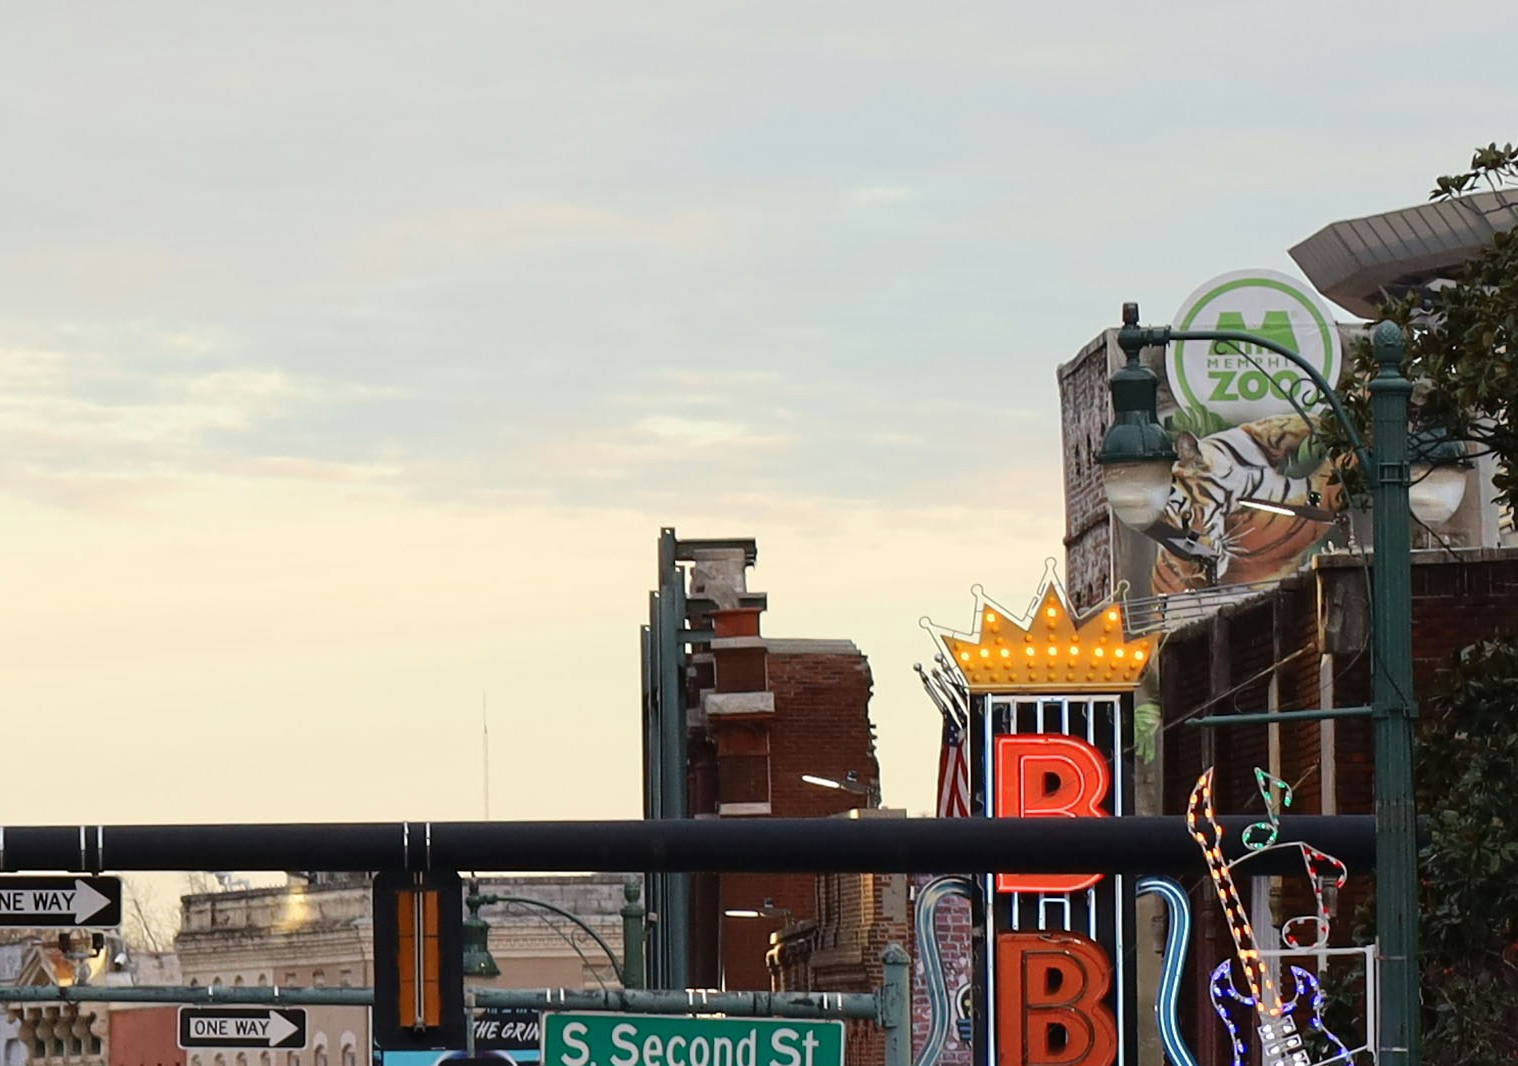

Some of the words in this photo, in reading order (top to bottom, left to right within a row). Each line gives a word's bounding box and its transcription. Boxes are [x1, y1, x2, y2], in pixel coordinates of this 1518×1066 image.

[1207, 371, 1302, 401] ZOO
[33, 891, 76, 912] WAY
[194, 1020, 228, 1036] ONE
[235, 1019, 269, 1036] WAY
